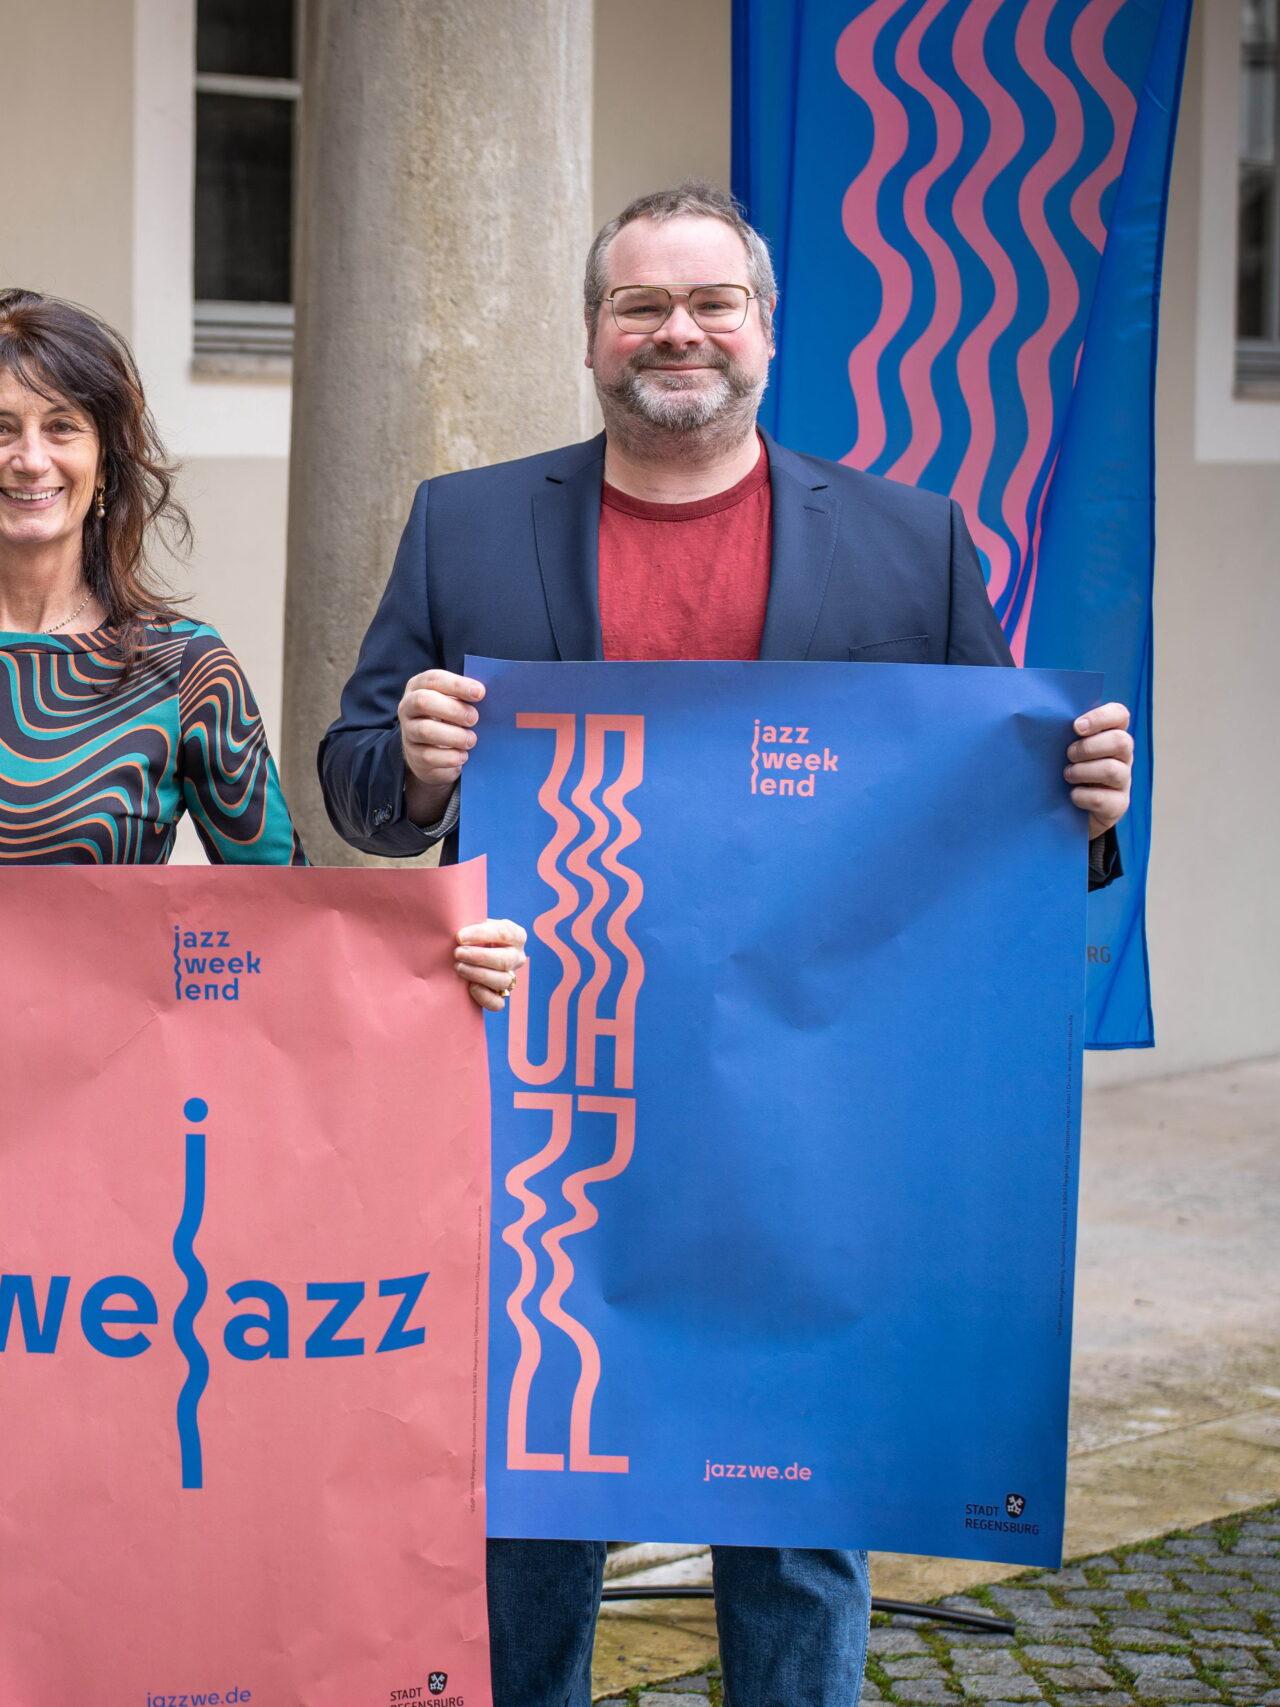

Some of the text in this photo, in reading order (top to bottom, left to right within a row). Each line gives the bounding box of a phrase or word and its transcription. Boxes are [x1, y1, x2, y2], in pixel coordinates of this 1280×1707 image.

[761, 747, 839, 772] week
[760, 773, 816, 797] end
[183, 950, 261, 974] week
[185, 977, 239, 1001] end
[704, 1460, 812, 1482] jazzwe.de
[965, 1504, 1000, 1517] STADT
[964, 1518, 1040, 1536] REGENSBURG
[147, 1686, 252, 1707] jazzwe.de
[390, 1687, 422, 1701] STADT
[391, 1696, 464, 1707] NSBURG
